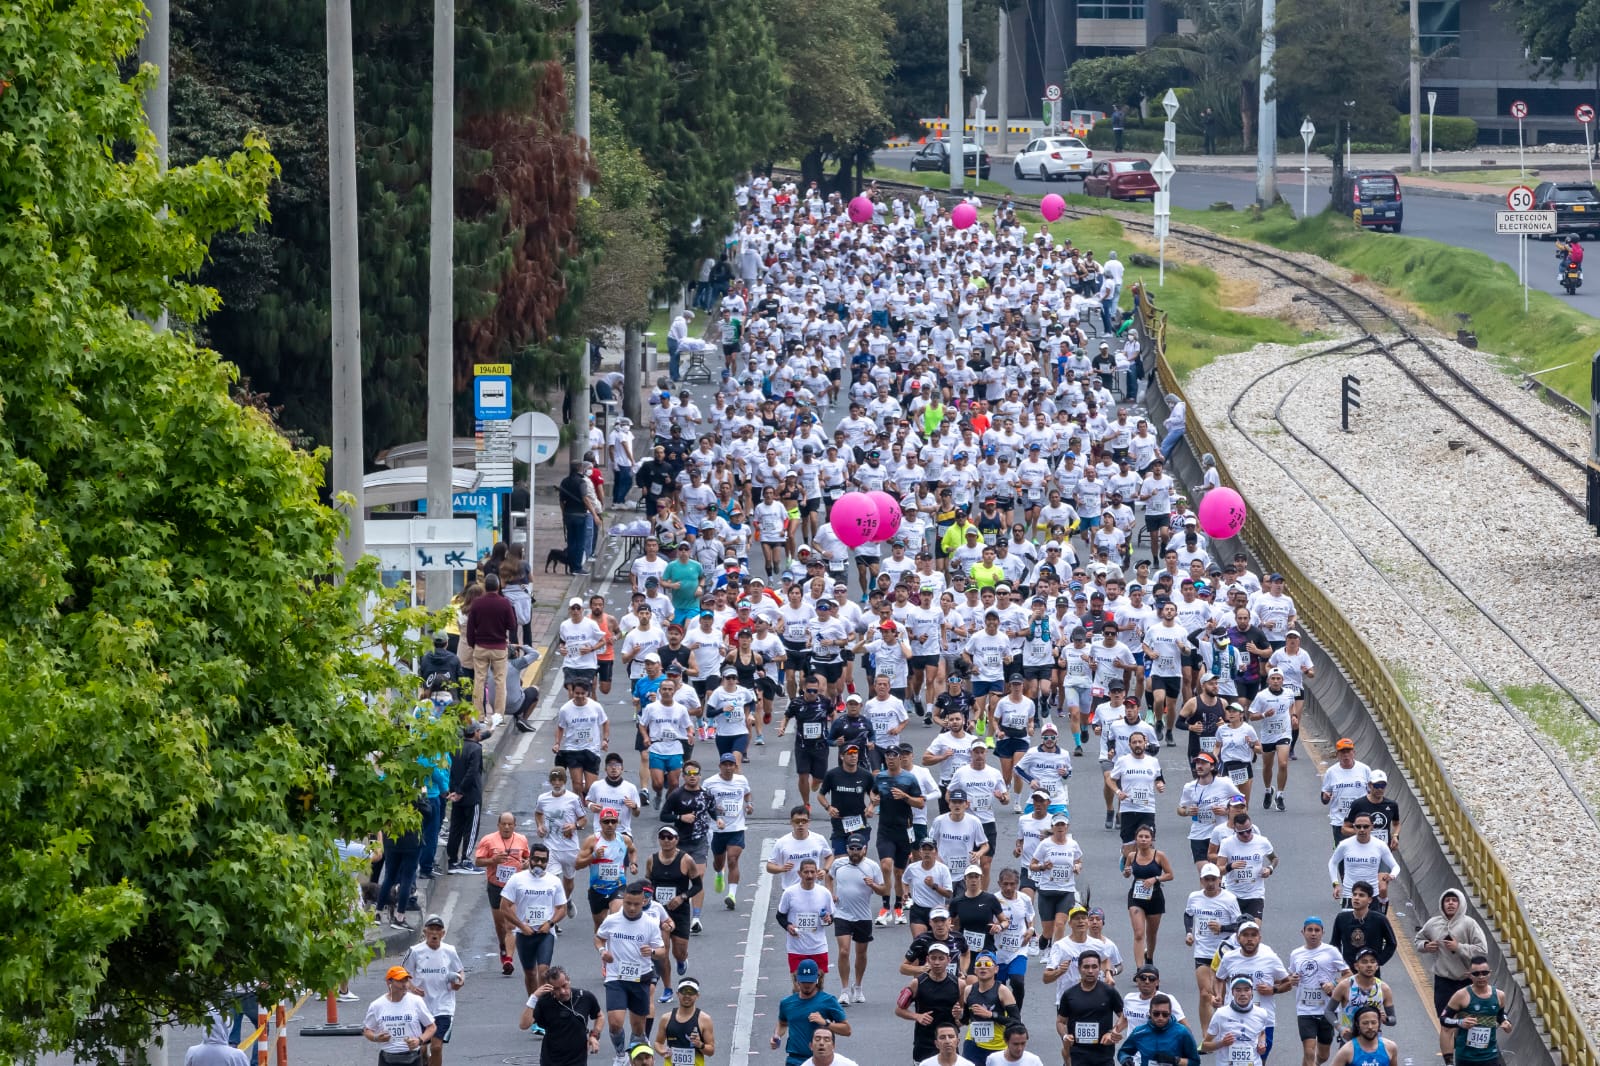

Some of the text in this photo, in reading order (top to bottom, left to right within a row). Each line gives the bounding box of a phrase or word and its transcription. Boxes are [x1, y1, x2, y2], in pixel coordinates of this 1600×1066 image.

[1048, 88, 1058, 96] 50
[1514, 193, 1531, 206] 50
[1238, 870, 1252, 878] 6315
[529, 910, 544, 919] 2181
[798, 918, 816, 926] 2835
[614, 932, 635, 941] Allianz
[1002, 936, 1018, 946] 9540
[620, 966, 639, 976] 2564
[1304, 992, 1321, 1000] 7708
[974, 1027, 990, 1036] 6101
[1078, 1028, 1096, 1038] 9863
[1471, 1032, 1488, 1042] 3145
[1232, 1051, 1250, 1060] 9552
